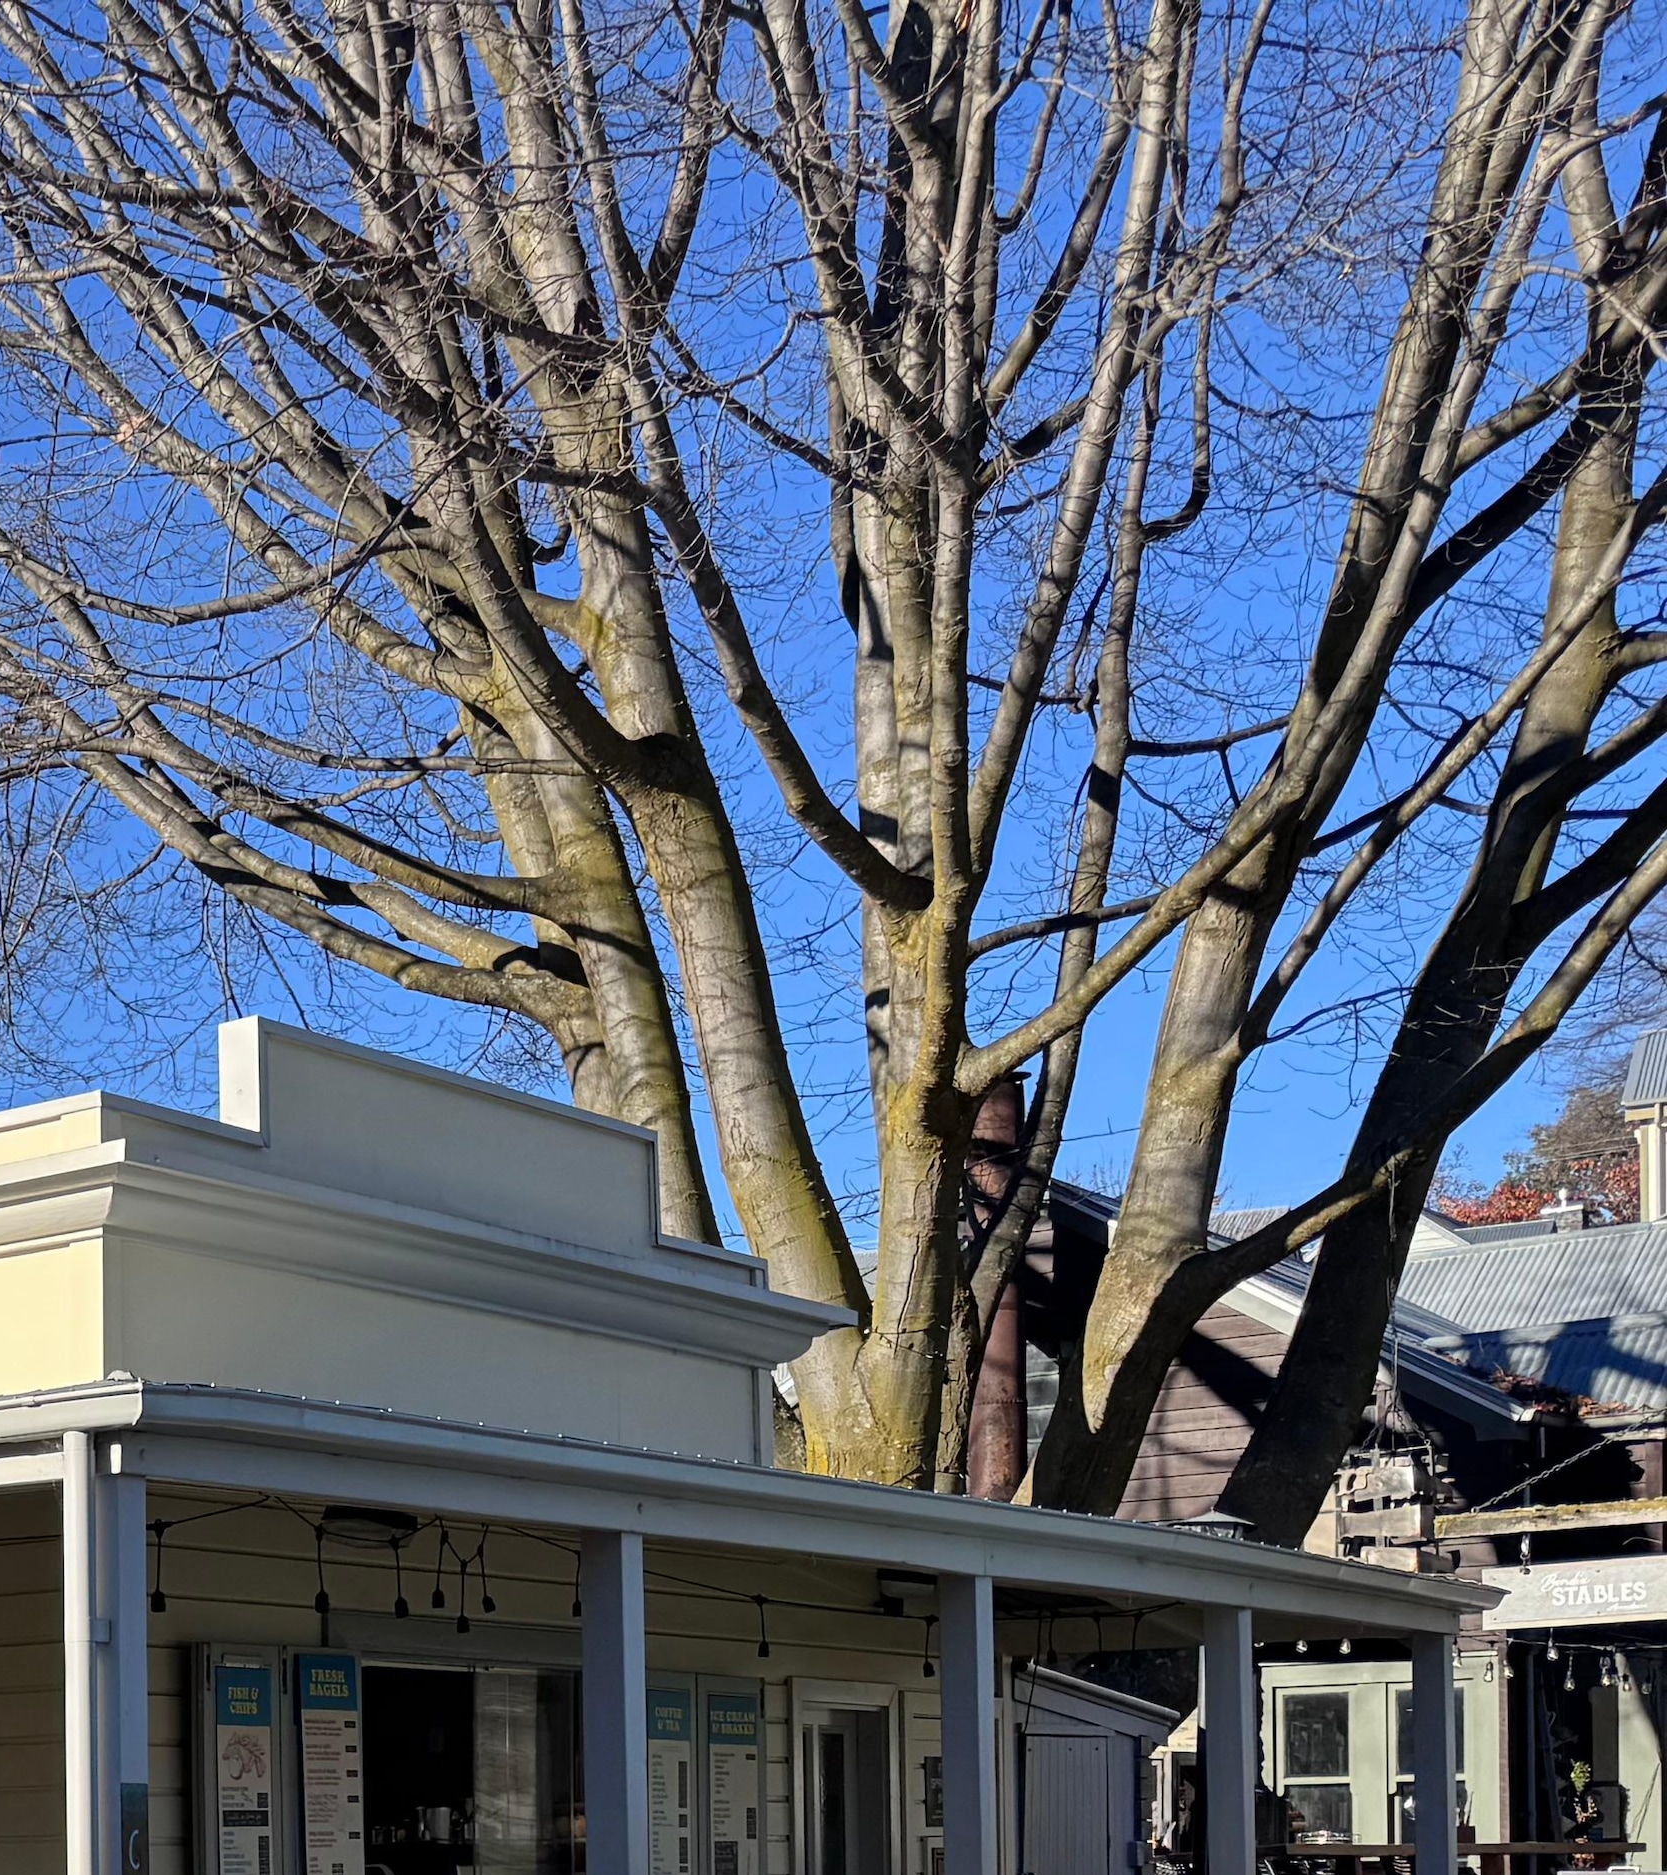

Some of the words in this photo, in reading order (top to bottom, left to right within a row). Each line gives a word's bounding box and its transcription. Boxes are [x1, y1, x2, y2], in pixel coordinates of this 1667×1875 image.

[1552, 1581, 1647, 1607] STABLES
[311, 1669, 345, 1682] FRESH
[228, 1686, 248, 1700] FISH
[309, 1683, 349, 1697] BAGELS
[229, 1701, 258, 1715] CHIPS
[655, 1707, 683, 1719] COFFEE
[726, 1711, 756, 1723] CREAM
[665, 1720, 680, 1732] TEA
